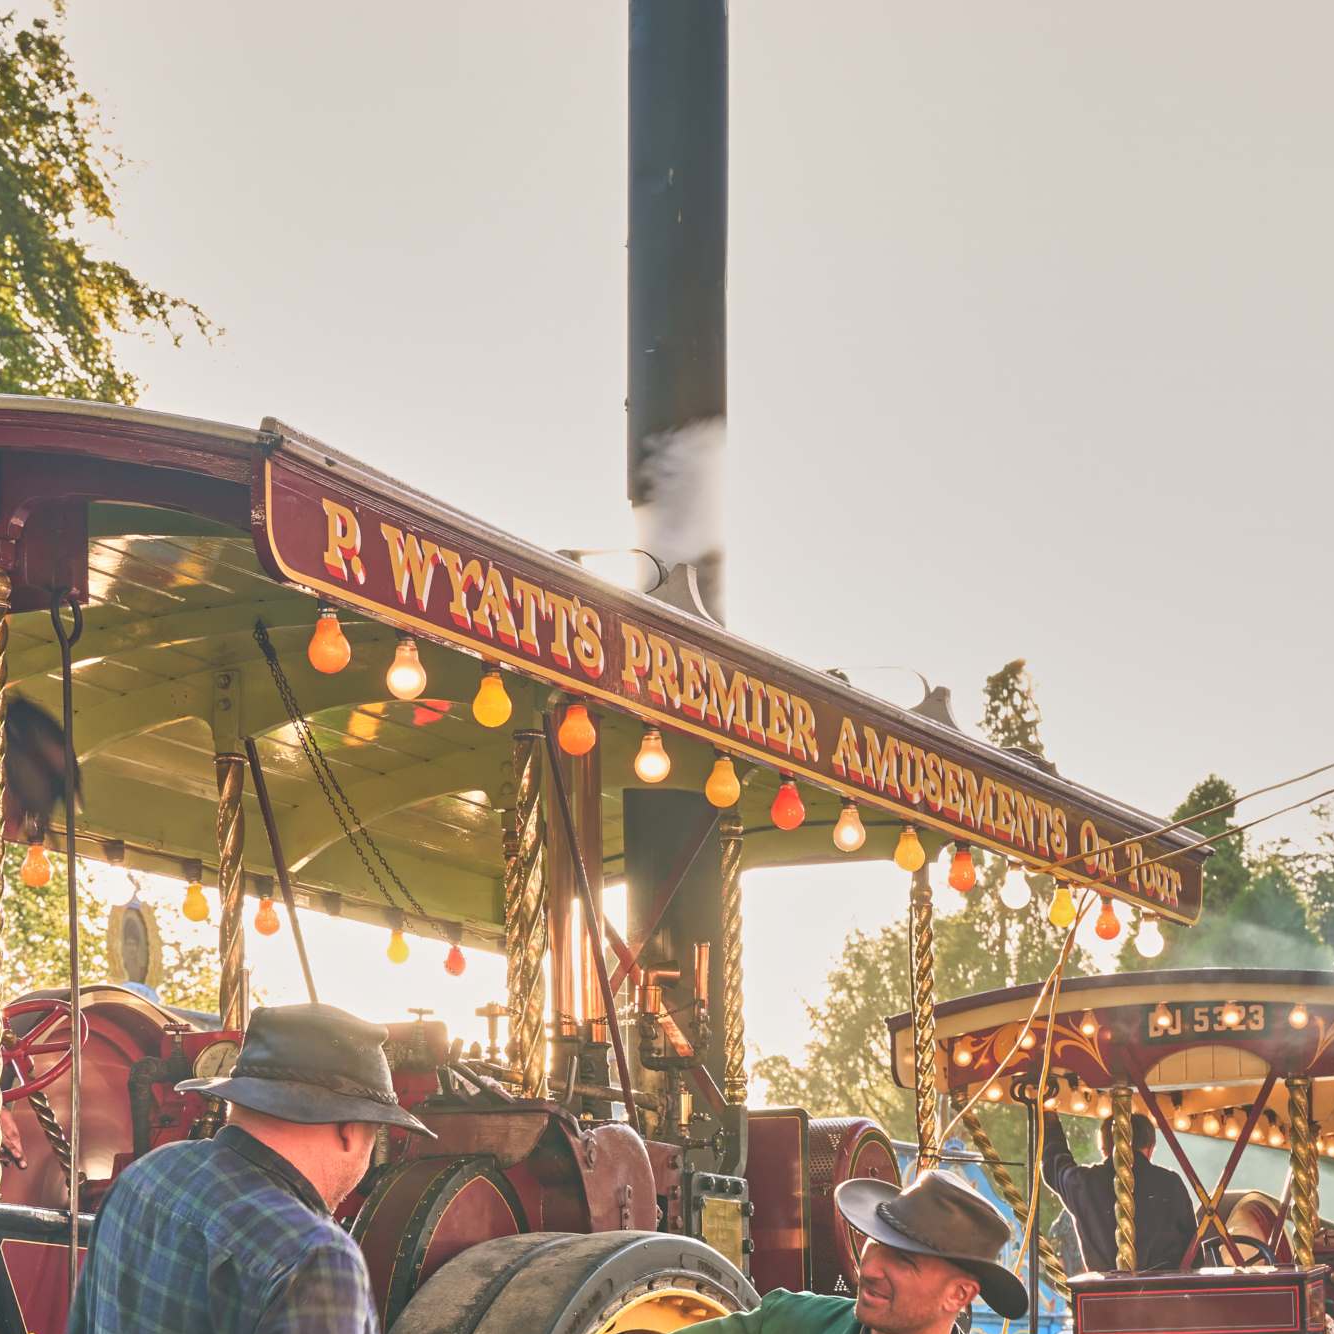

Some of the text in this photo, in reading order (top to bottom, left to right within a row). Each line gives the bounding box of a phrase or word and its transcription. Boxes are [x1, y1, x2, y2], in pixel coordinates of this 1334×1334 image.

[322, 497, 366, 585] P.
[620, 620, 819, 763] PREMIER
[831, 716, 1068, 861] AMUSEMENTS
[1125, 842, 1182, 908] Tour
